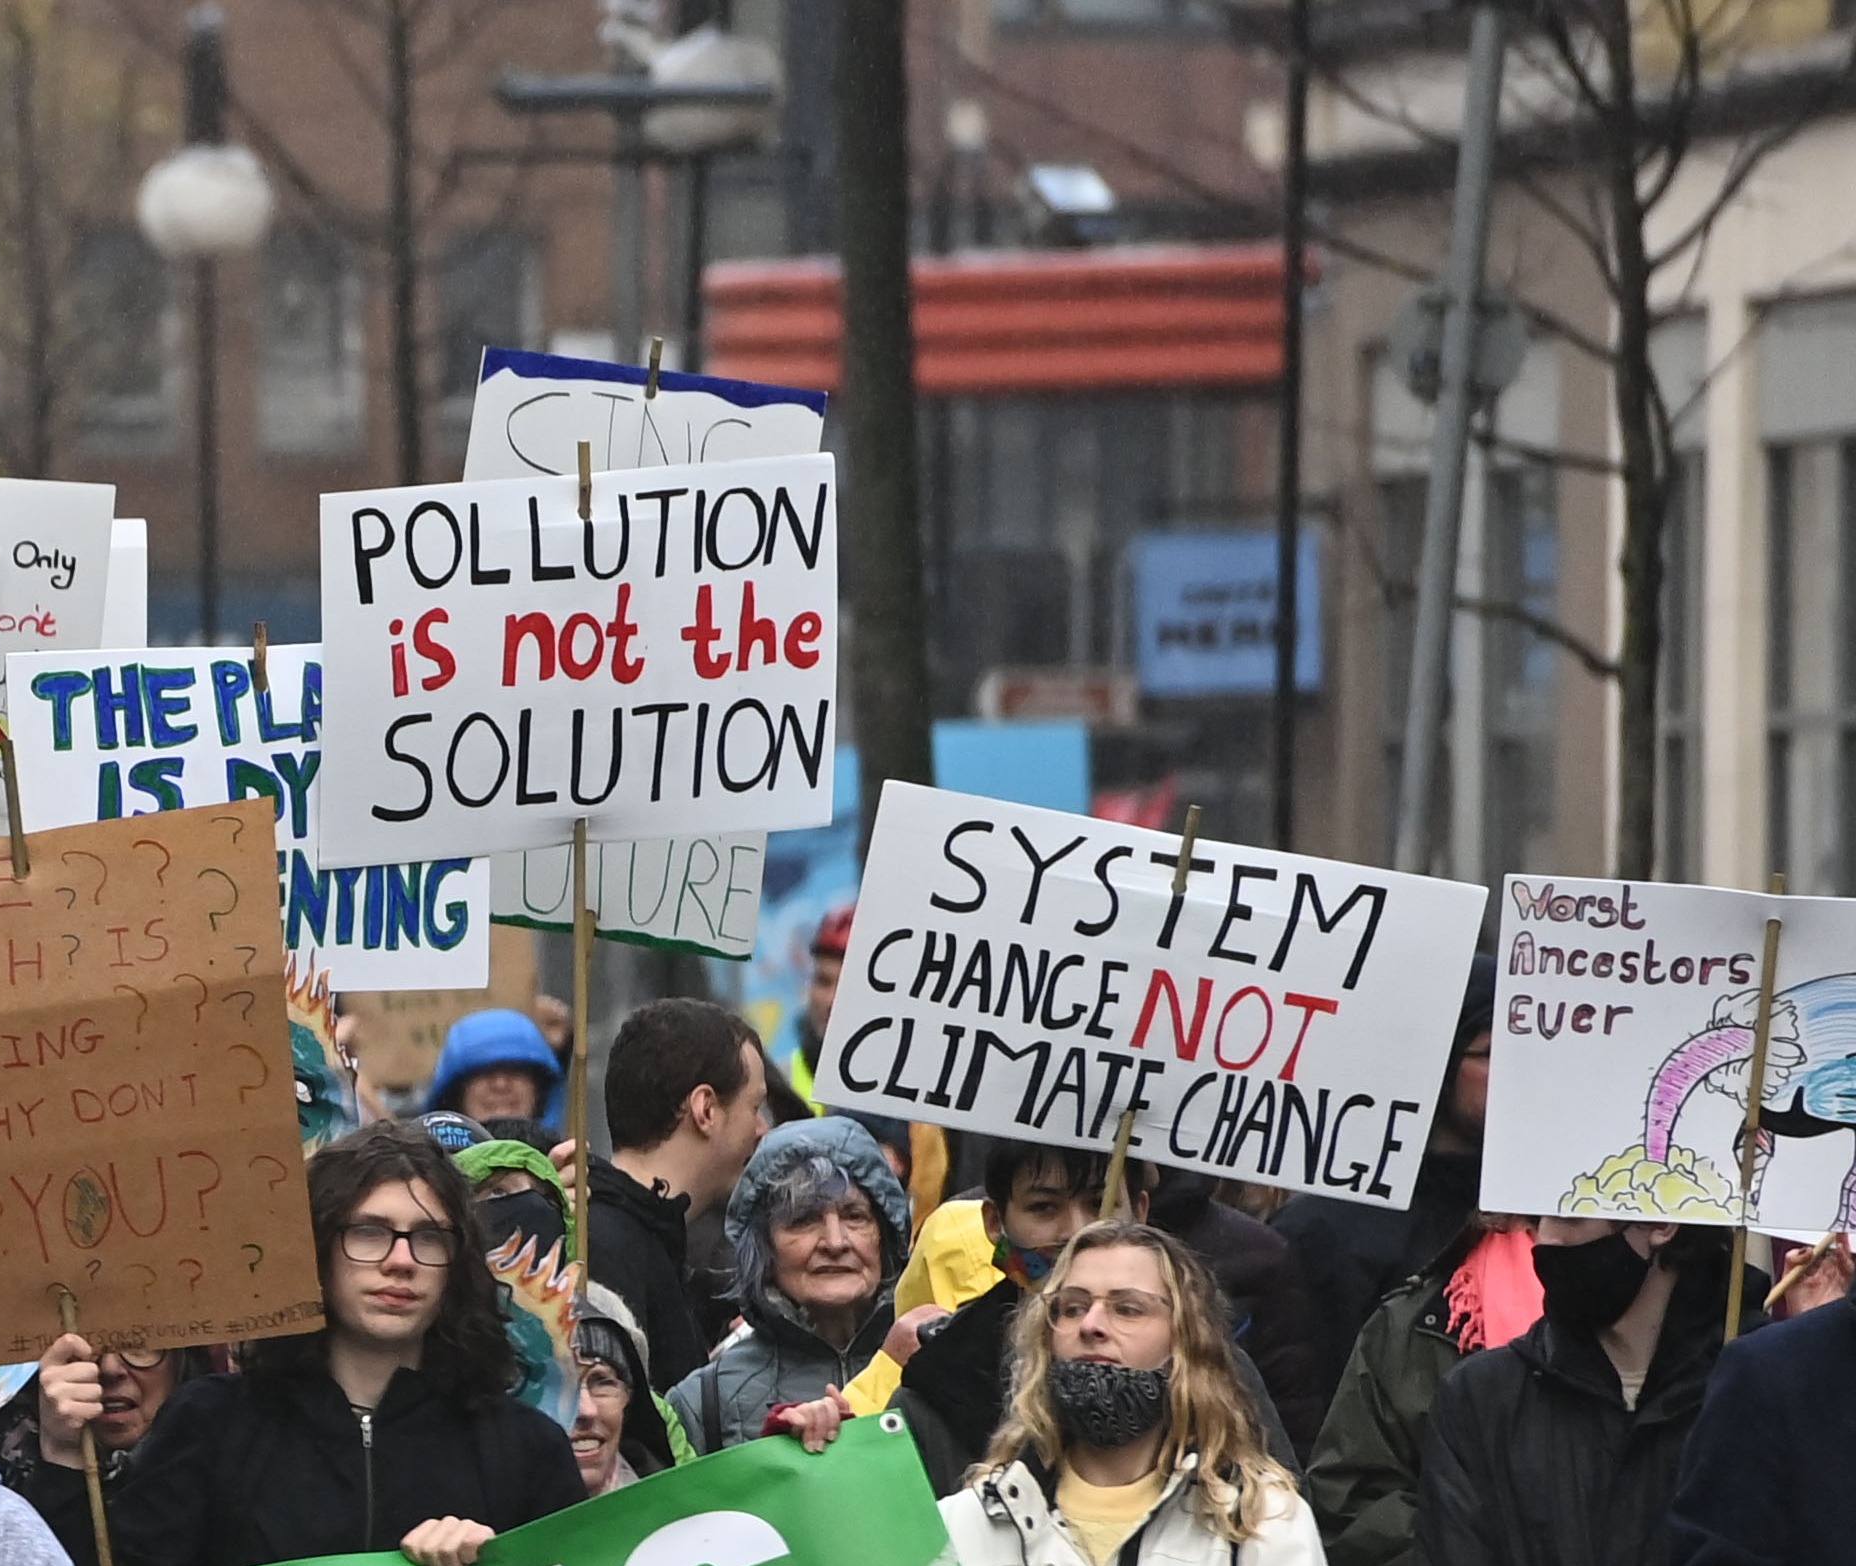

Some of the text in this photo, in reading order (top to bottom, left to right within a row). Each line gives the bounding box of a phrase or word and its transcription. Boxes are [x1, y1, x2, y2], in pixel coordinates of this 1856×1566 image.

[13, 540, 77, 590] Only
[351, 483, 829, 605] POLLUTION
[388, 580, 823, 698] is not the
[30, 658, 322, 752] THE PLA
[97, 756, 186, 823] IS
[371, 698, 829, 822] SOLUTION
[274, 848, 472, 952] NYING
[522, 838, 759, 942] UTURE
[929, 820, 1388, 991] SYSTEM
[1510, 879, 1647, 931] Worst
[106, 917, 170, 969] IS
[1508, 930, 1756, 986] Ancestors
[867, 928, 1339, 1082] CHANGE NOT
[1507, 994, 1634, 1040] Ever
[72, 1072, 199, 1125] DON'T
[427, 1125, 473, 1138] lster
[839, 1016, 1420, 1199] CLIMATE CHANGE
